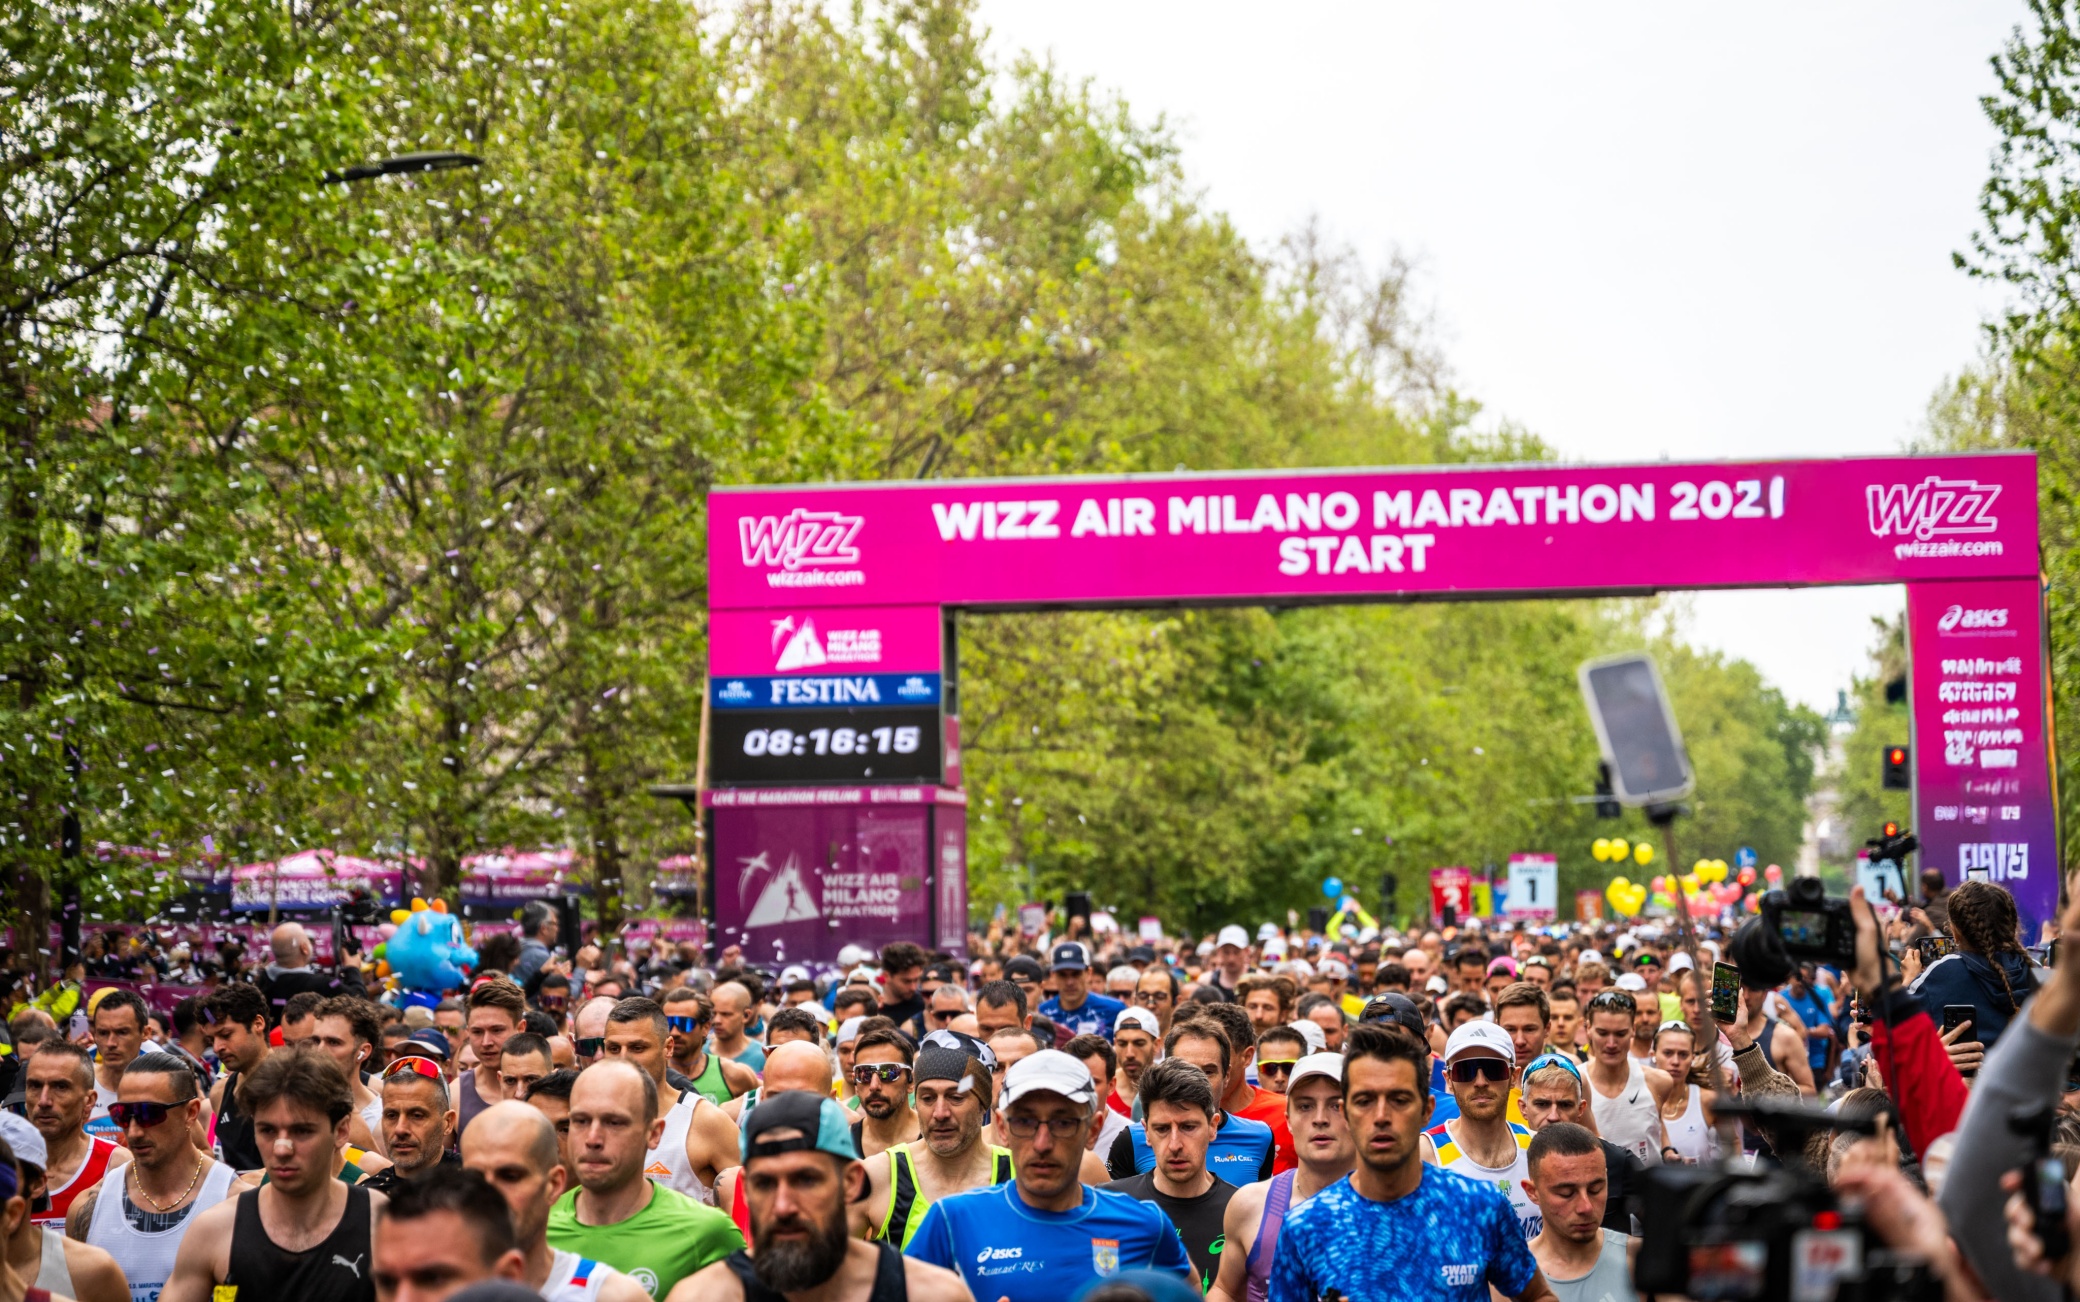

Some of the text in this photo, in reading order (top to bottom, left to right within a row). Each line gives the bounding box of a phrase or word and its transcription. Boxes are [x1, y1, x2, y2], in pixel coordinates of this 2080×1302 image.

[931, 500, 1061, 542] WIZZ
[1070, 498, 1157, 538] AIR
[1168, 491, 1361, 534] MILANO
[1373, 483, 1656, 529] MARATHON
[1278, 533, 1436, 577] START
[766, 567, 866, 588] wizzair.com
[827, 628, 882, 640] WIZZ AIR
[827, 640, 883, 651] MILANO
[770, 677, 881, 704] FESTINA
[743, 725, 921, 756] 08:16:15
[711, 790, 861, 805] LIVE THE MARATHON FEELING
[821, 872, 898, 887] WIZZ AIR
[821, 888, 900, 904] MILANO
[1527, 879, 1536, 902] 1
[821, 904, 898, 918] MARATHON
[991, 1246, 1023, 1260] asics
[1441, 1263, 1479, 1277] SWATT
[1446, 1274, 1475, 1287] CLUB
